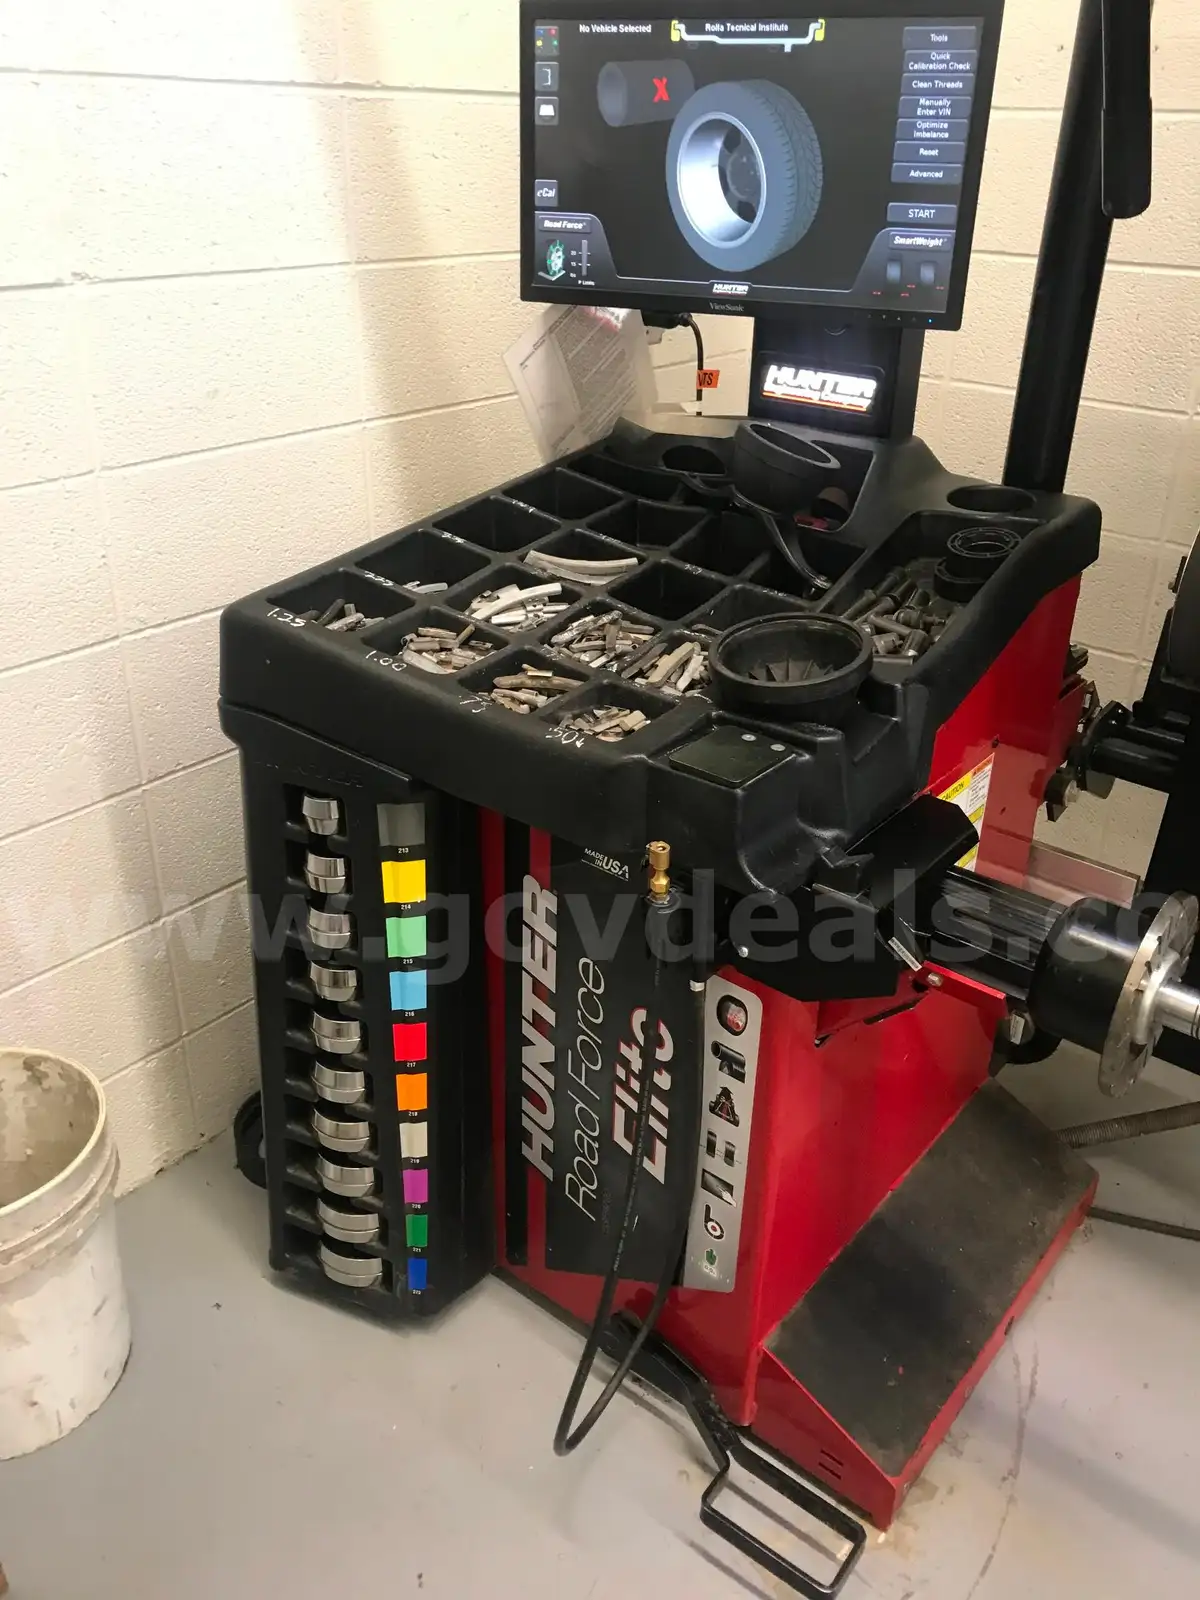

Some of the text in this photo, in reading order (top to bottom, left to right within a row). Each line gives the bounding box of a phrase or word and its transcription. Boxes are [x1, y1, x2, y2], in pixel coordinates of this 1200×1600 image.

[579, 24, 652, 33] No Vehicle Selected
[704, 22, 789, 32] Rolla Tecnical Institute
[930, 33, 948, 42] Tools
[930, 52, 950, 61] Quick
[908, 62, 971, 71] Calibration Check
[911, 80, 963, 89] Clean Threads
[918, 98, 951, 107] Manually
[916, 107, 951, 116] Enter VIN
[916, 120, 949, 130] Optimize
[913, 130, 949, 139] Imbalance
[918, 147, 939, 156] Reset
[909, 169, 943, 178] Advanced
[908, 208, 936, 219] START
[713, 283, 749, 292] HUNTER
[709, 302, 745, 312] ViewSonic
[764, 364, 877, 400] HUNTER
[584, 848, 604, 860] MADE
[602, 856, 629, 879] USA
[521, 874, 558, 1182] HUNTER
[565, 957, 605, 1222] Road Force
